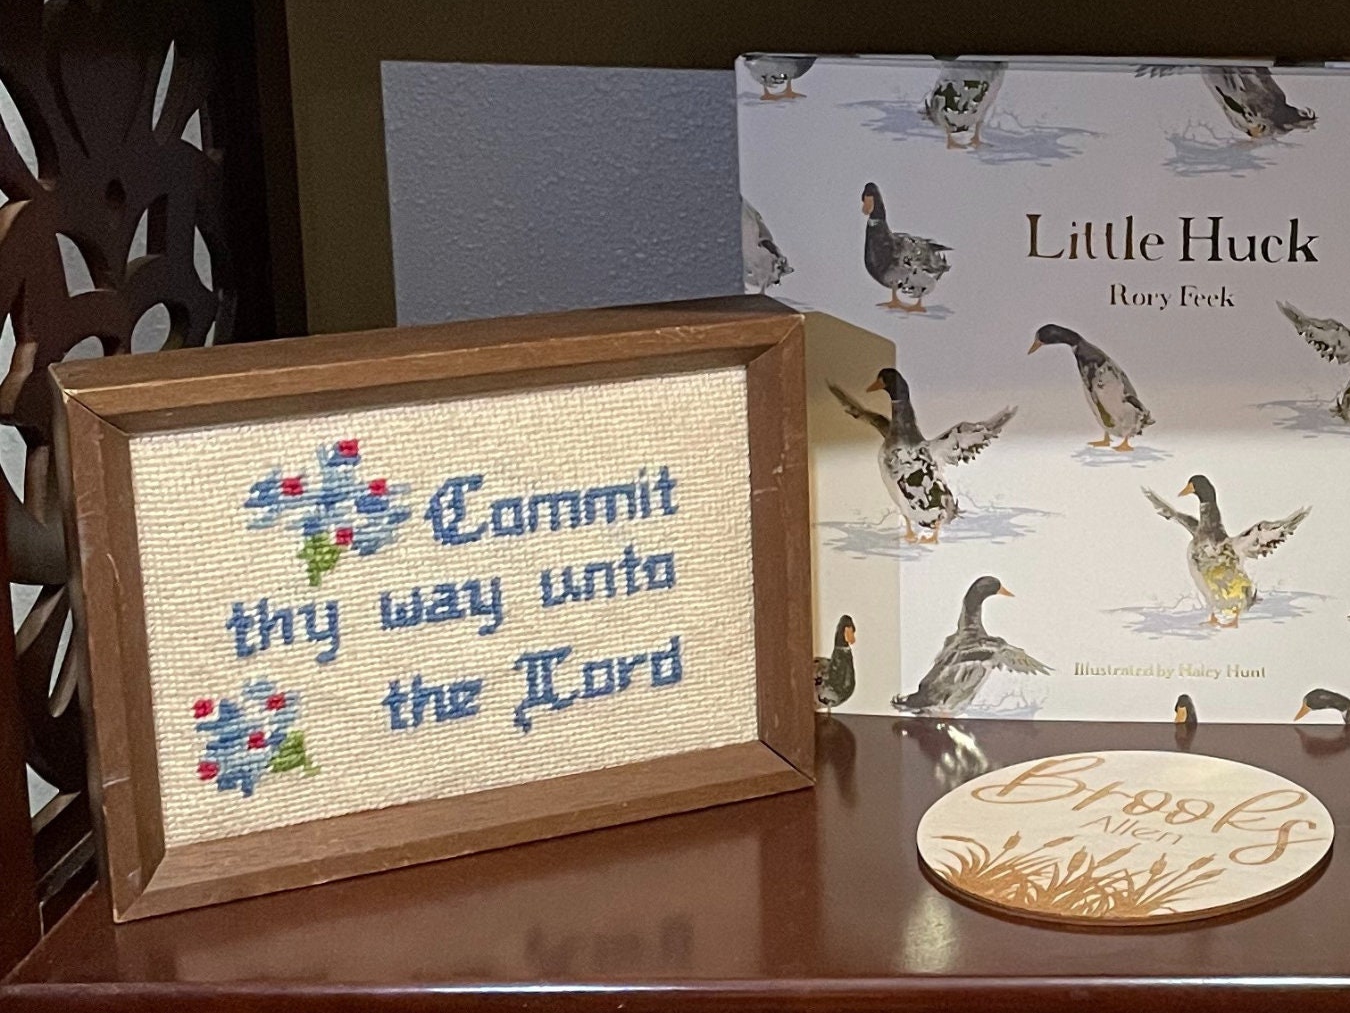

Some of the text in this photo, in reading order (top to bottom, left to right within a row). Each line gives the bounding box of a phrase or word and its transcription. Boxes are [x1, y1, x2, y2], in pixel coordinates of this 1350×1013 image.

[1026, 213, 1319, 263] Little Huck
[1109, 283, 1235, 310] Rory Feek
[424, 466, 678, 545] Commit
[226, 545, 675, 664] thy way unto
[383, 636, 684, 734] the Lord
[1074, 662, 1266, 679] Illustrated by Haley Hunt
[971, 756, 1327, 865] Brooks
[1078, 815, 1183, 846] Allen
